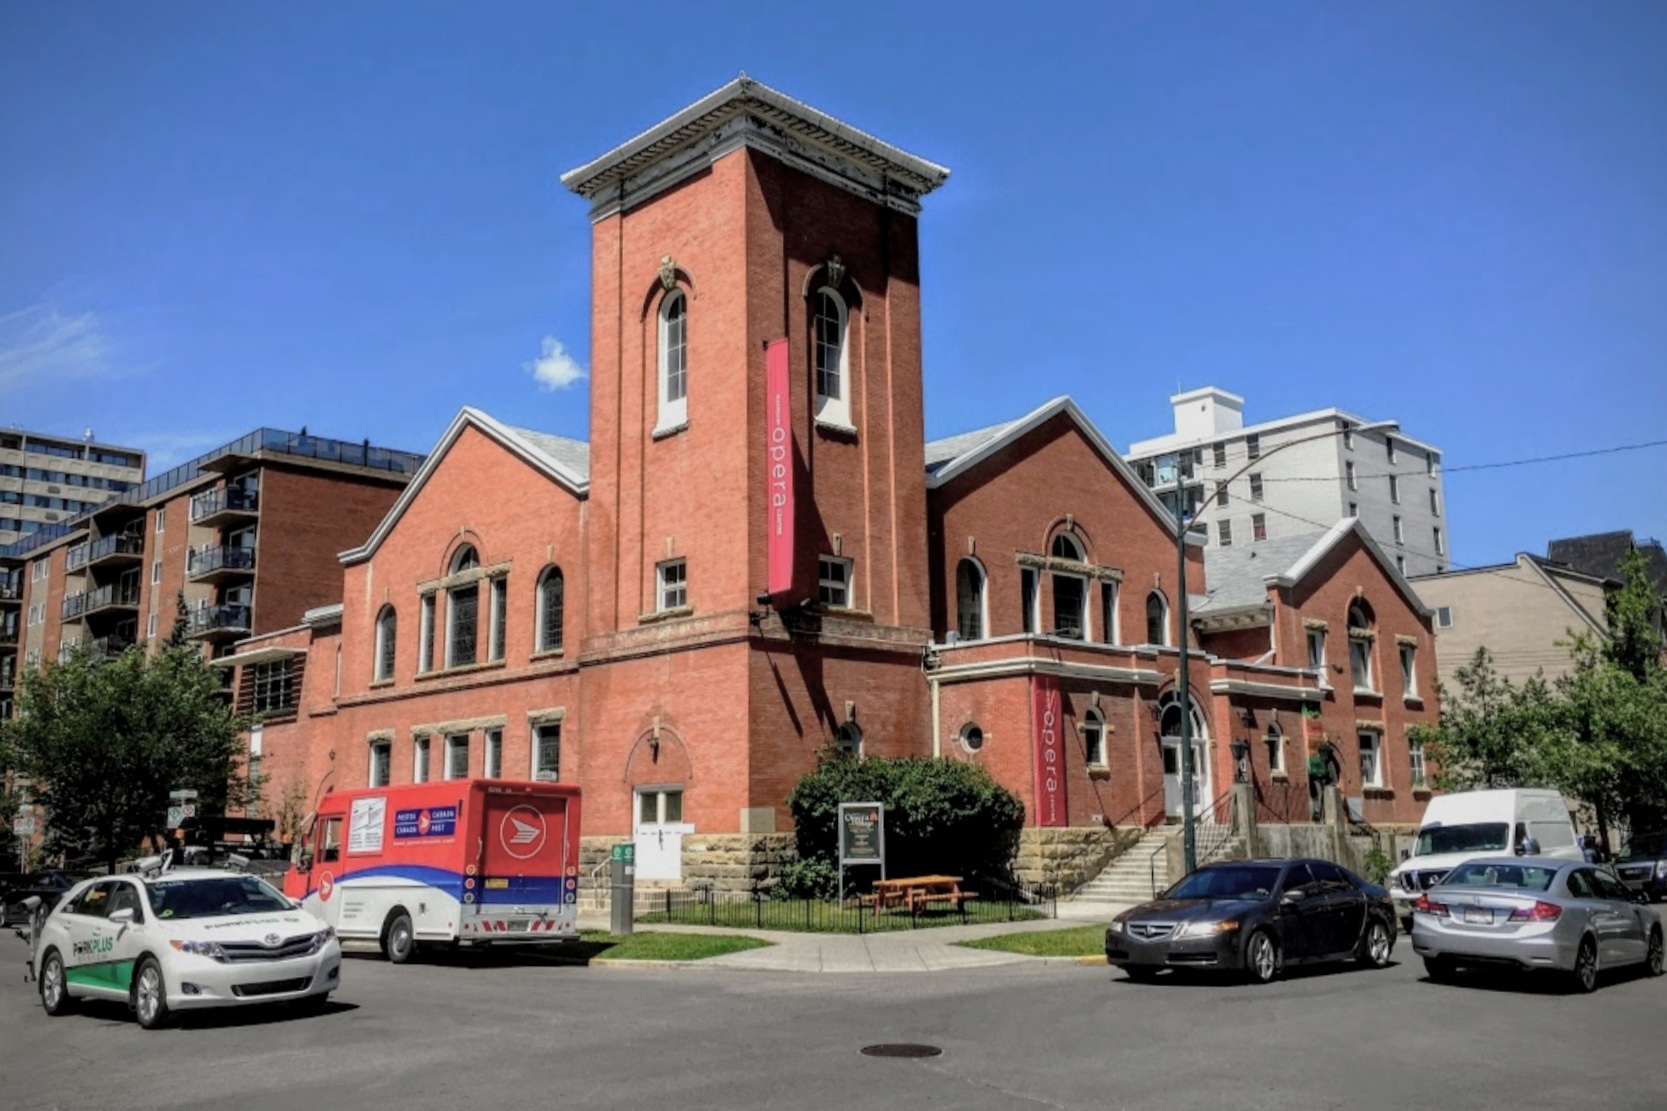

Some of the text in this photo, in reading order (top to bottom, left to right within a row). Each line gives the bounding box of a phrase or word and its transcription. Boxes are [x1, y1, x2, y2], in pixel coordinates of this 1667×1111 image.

[770, 427, 787, 507] opera
[1042, 710, 1057, 792] opera
[396, 823, 445, 835] CANADA POST
[431, 810, 454, 819] CANADA
